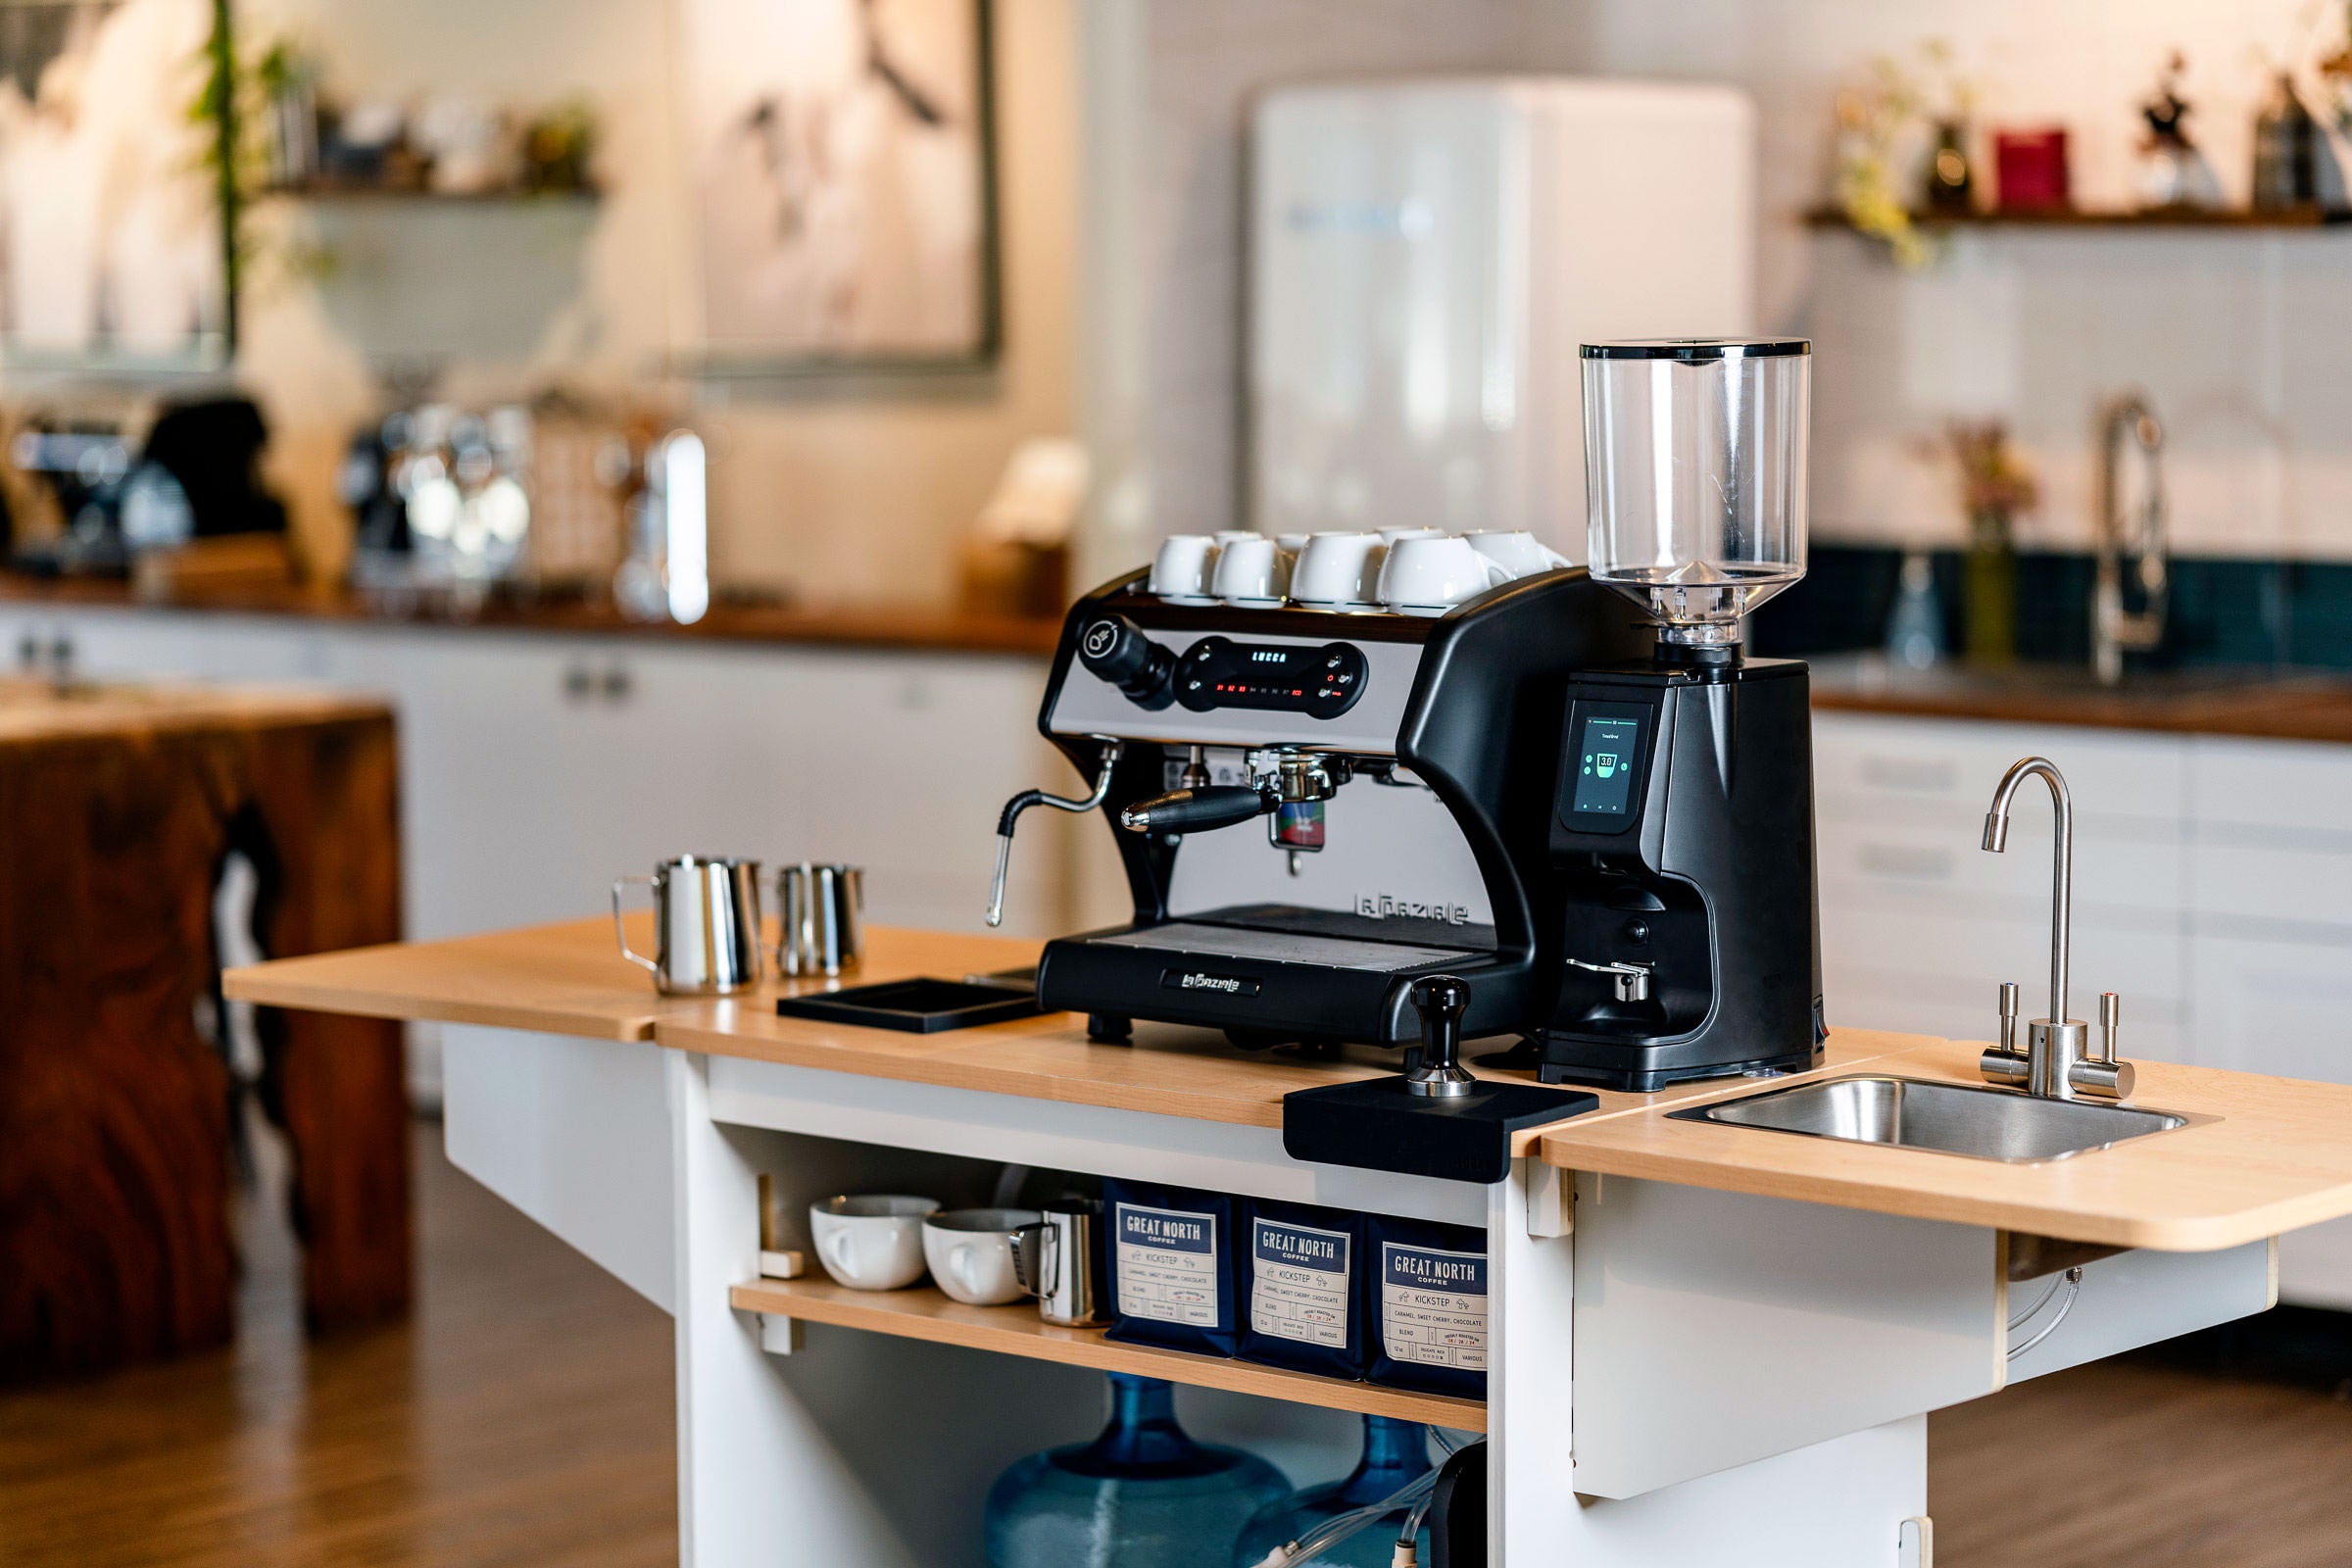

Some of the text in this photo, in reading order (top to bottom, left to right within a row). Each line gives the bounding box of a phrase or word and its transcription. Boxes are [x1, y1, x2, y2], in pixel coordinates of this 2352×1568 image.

[1251, 651, 1287, 663] LUCCA
[1600, 757, 1612, 766] 3.0
[1126, 1215, 1200, 1240] GREAT NORTH
[1148, 1236, 1176, 1245] COFFEE
[1262, 1231, 1334, 1259] GREAT NORTH
[1146, 1253, 1178, 1264] KICKSTEP
[1282, 1252, 1309, 1262] COFFEE
[1395, 1255, 1475, 1281] GREAT NORTH
[1279, 1270, 1310, 1283] KICKSTEP
[1417, 1276, 1447, 1286] COFFEE
[1312, 1295, 1339, 1304] CHOCOLATE
[1414, 1295, 1450, 1307] KICKSTEP
[1417, 1313, 1431, 1322] SWEET
[1452, 1318, 1482, 1327] CHOCOLATE
[1398, 1328, 1414, 1337] BLEND
[1462, 1354, 1483, 1363] VARIOUS
